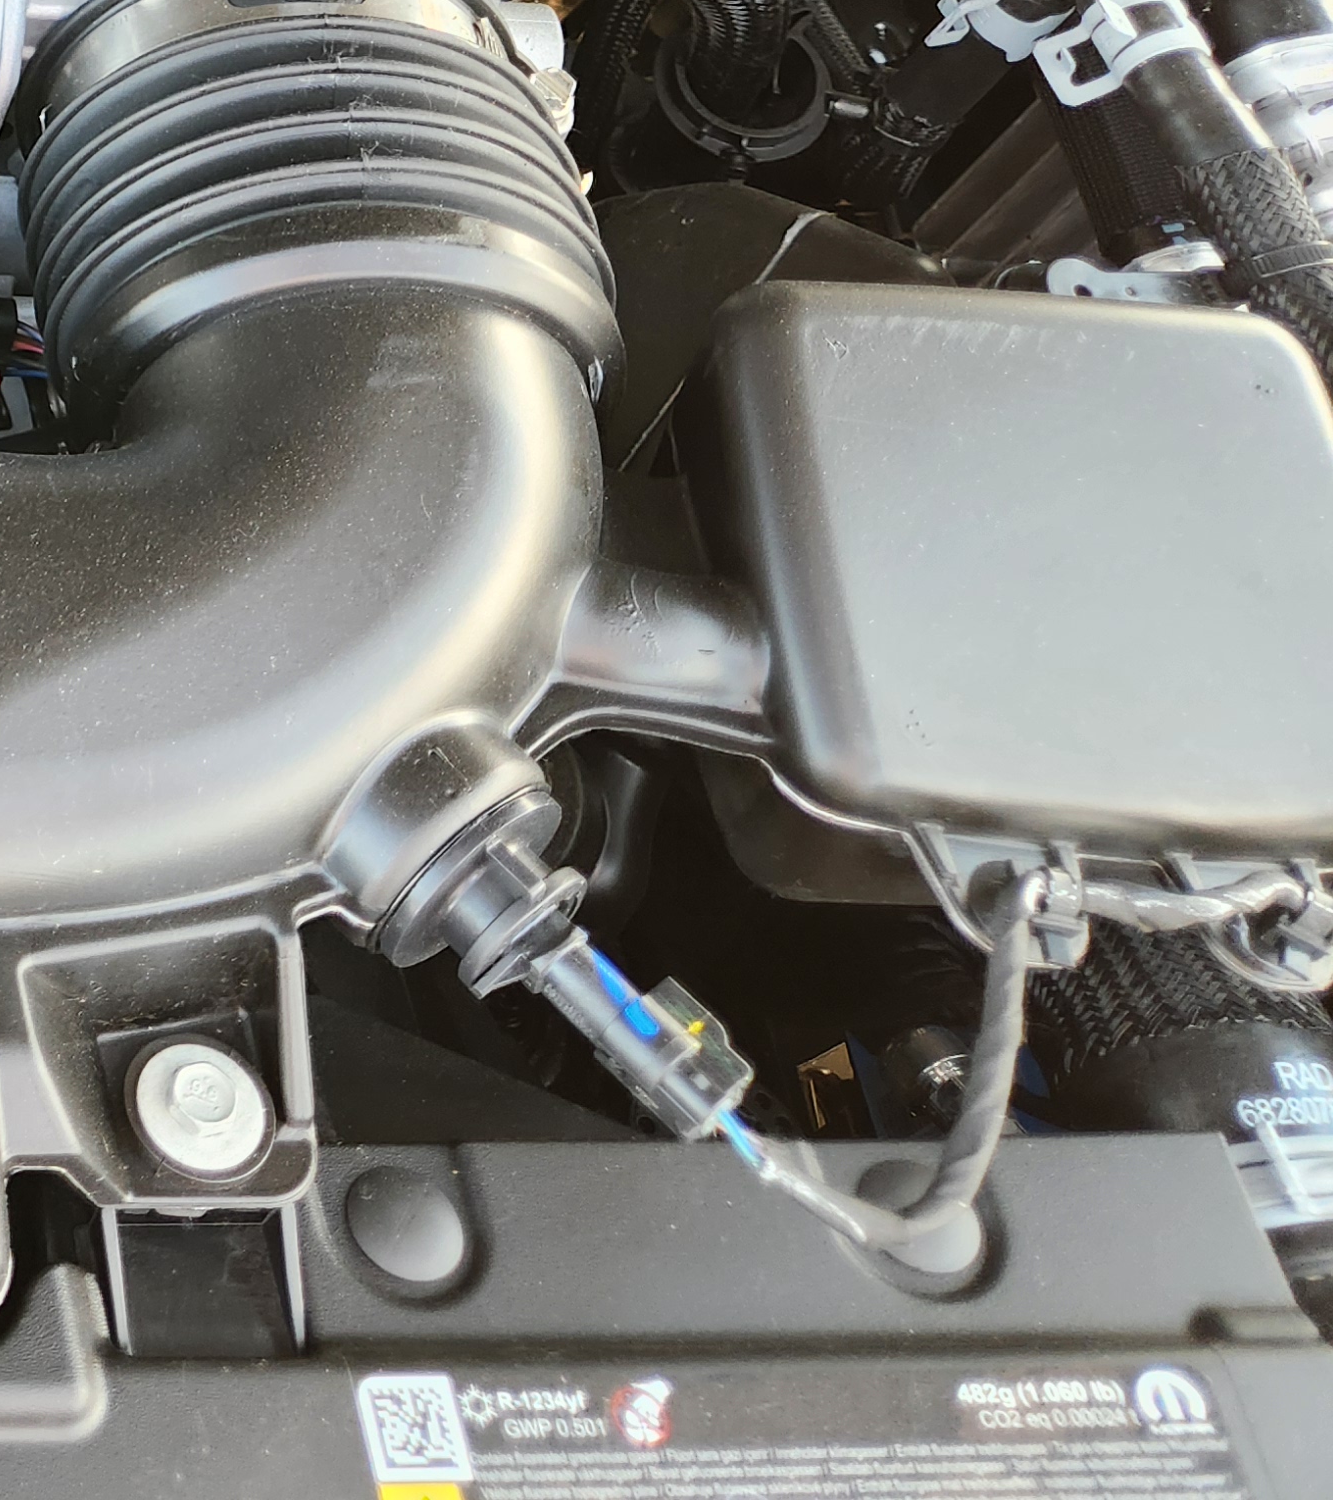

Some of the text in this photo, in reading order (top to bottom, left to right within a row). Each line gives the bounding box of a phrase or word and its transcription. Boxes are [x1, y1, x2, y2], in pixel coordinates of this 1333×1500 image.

[1272, 1061, 1333, 1091] RAD
[496, 1390, 586, 1414] R-1234yf
[956, 1382, 1016, 1408] 482g
[1090, 1381, 1125, 1406] lb)
[504, 1417, 607, 1438] GWP 0.501
[978, 1409, 1024, 1429] CO2
[1025, 1411, 1054, 1431] eq
